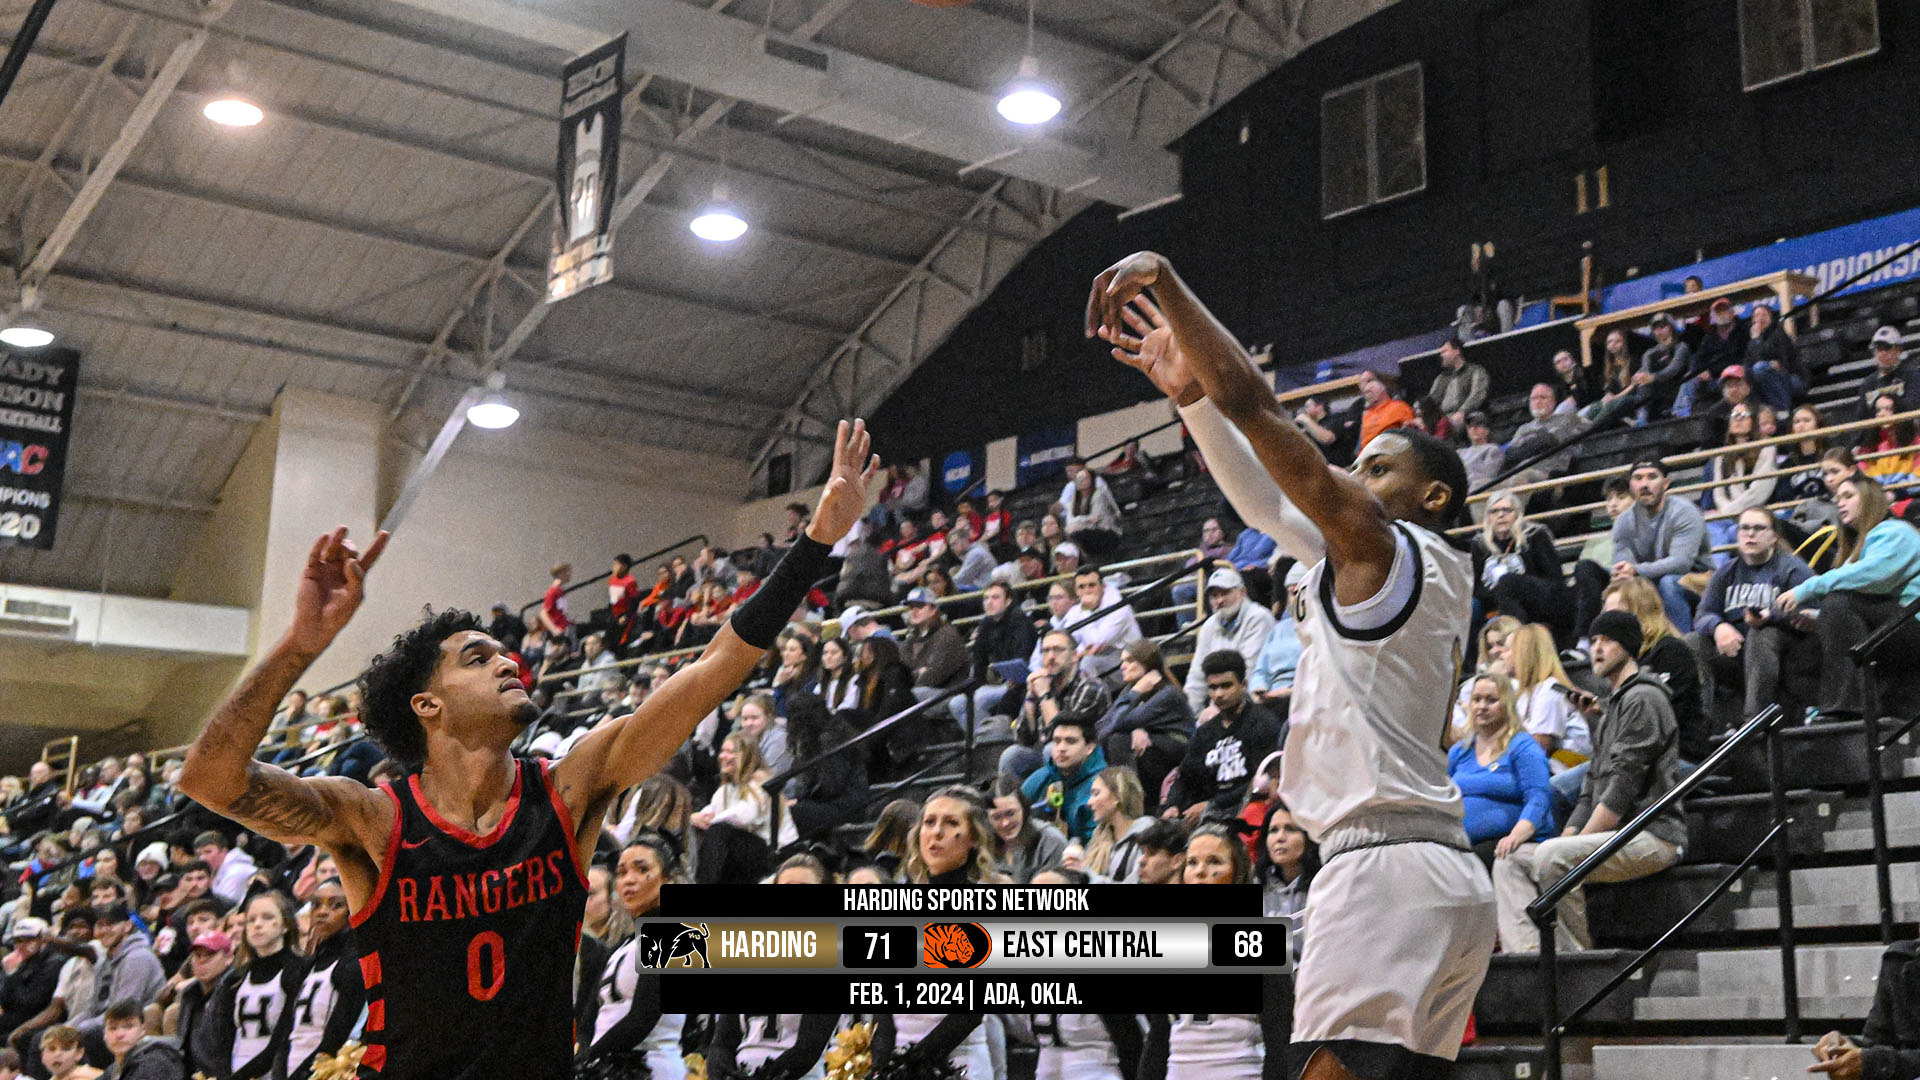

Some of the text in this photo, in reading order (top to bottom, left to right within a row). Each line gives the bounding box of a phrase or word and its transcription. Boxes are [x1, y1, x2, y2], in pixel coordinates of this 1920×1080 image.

[0, 353, 65, 385] ADY
[0, 381, 66, 412] SON
[0, 439, 49, 475] AC
[0, 486, 51, 509] PIONS
[0, 511, 41, 540] 20
[397, 850, 563, 923] RANGERS
[467, 930, 505, 1002] 0
[238, 994, 275, 1039] H
